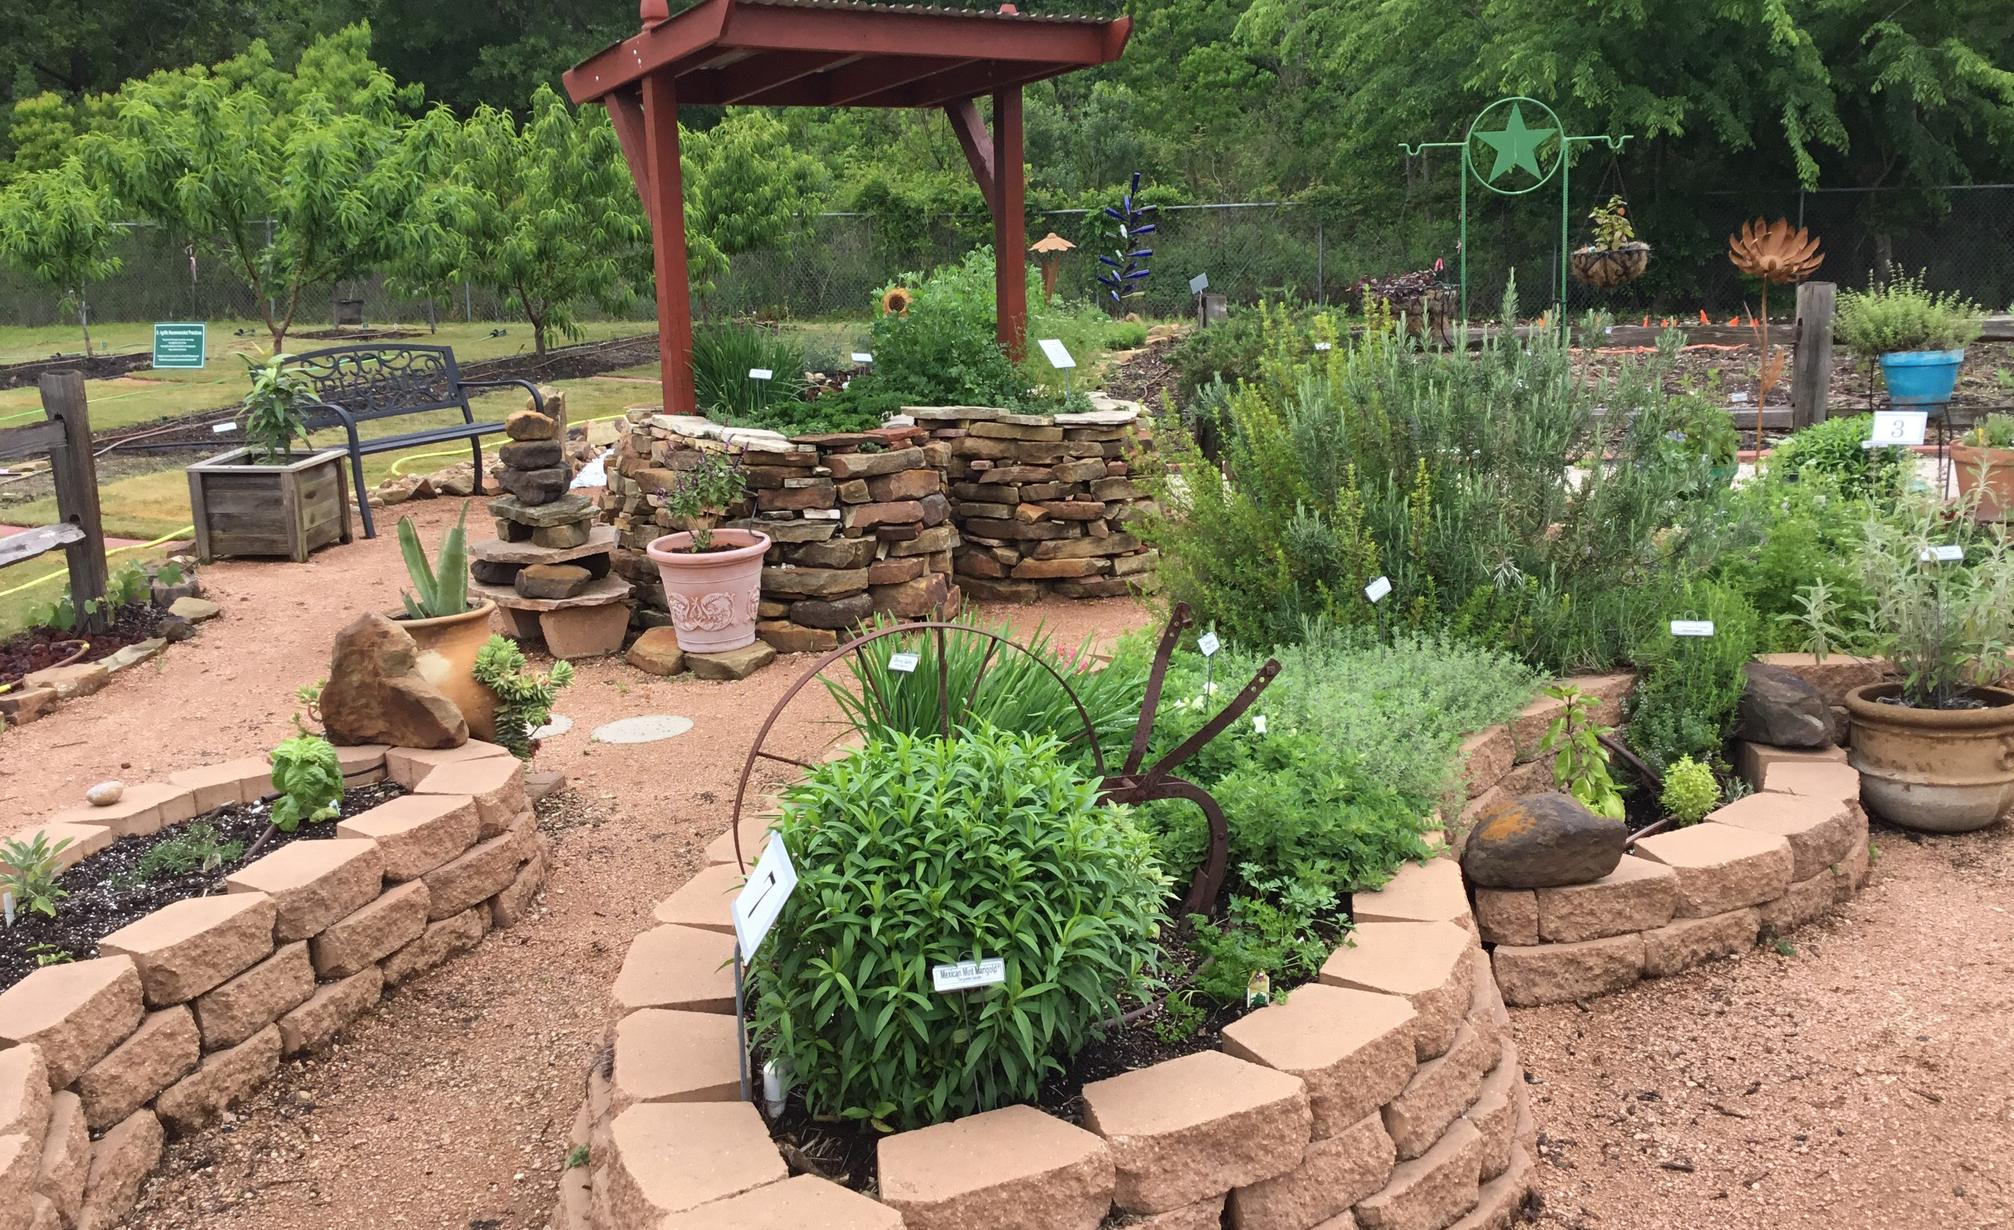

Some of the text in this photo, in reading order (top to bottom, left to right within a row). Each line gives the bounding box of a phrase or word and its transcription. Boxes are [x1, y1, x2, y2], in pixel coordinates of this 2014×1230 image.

[1891, 420, 1904, 438] 3
[940, 968, 962, 978] Mexican
[962, 966, 974, 976] Mint
